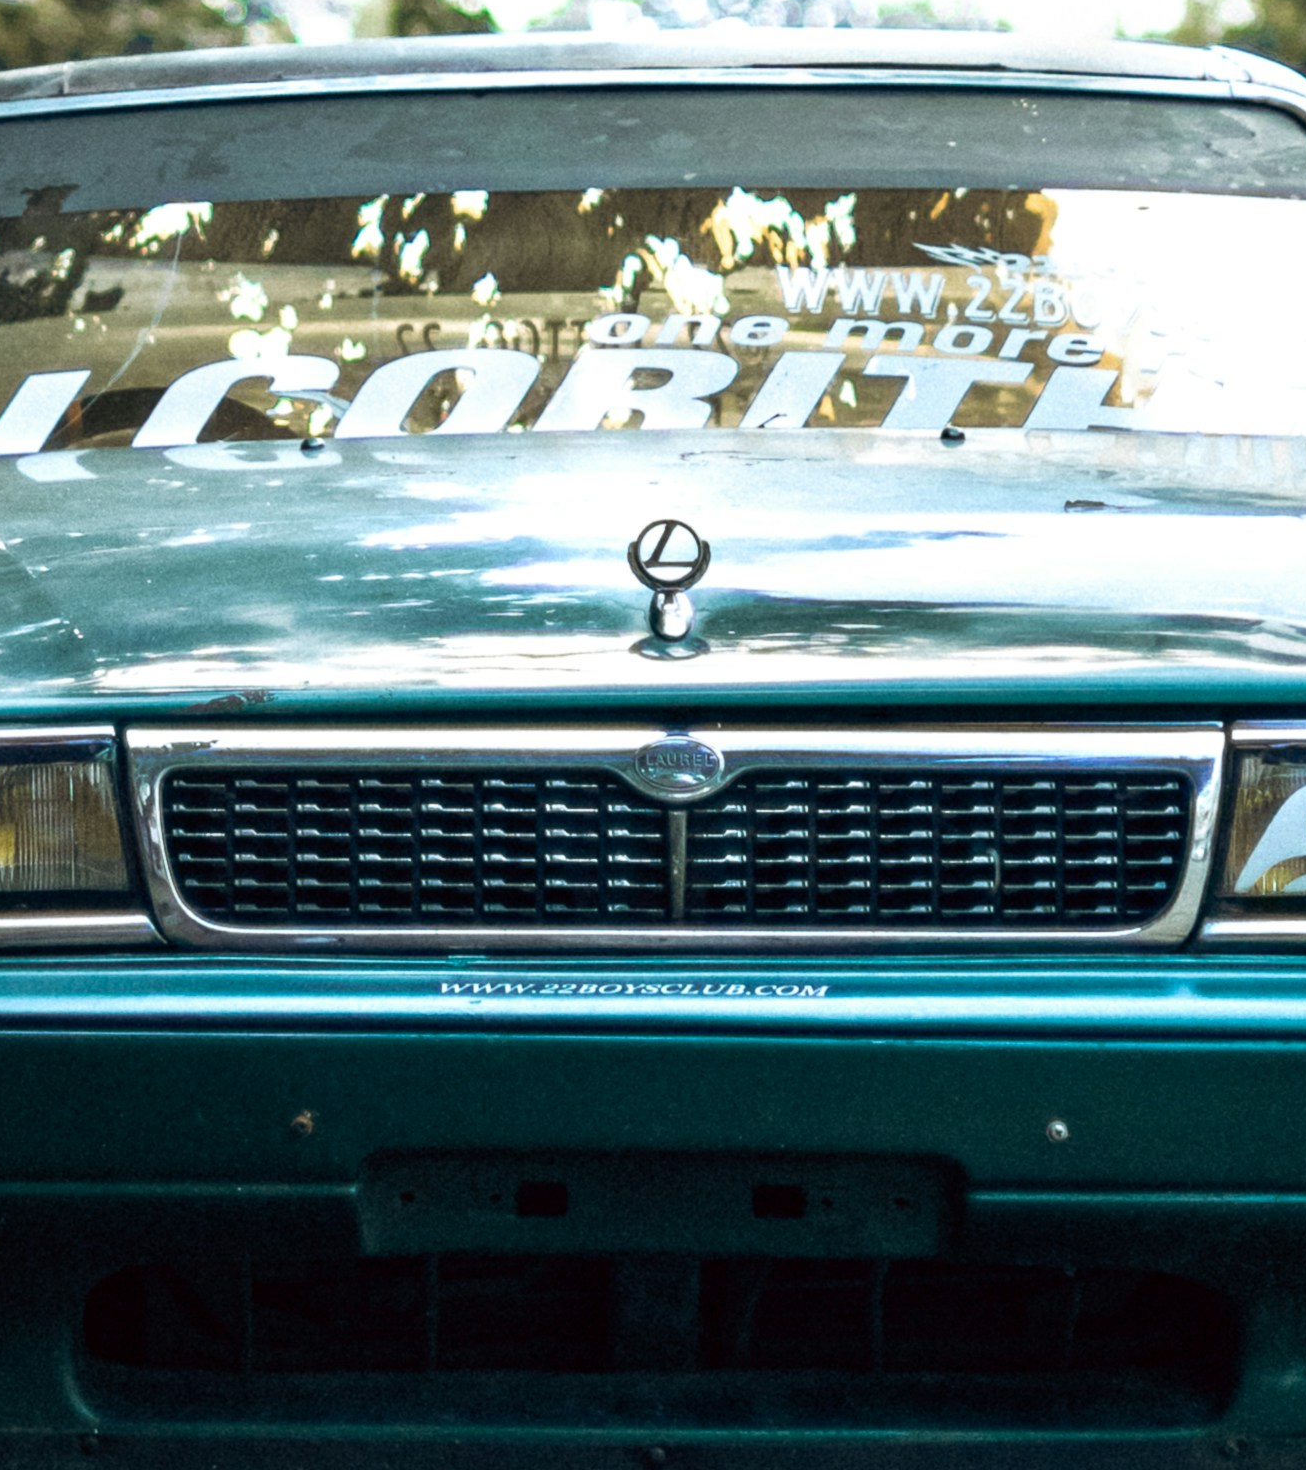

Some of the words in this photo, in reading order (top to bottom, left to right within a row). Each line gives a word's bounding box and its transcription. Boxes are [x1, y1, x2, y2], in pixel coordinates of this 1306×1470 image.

[590, 312, 790, 347] one
[823, 318, 1105, 366] more
[644, 751, 714, 768] LAUREL
[441, 982, 830, 997] WWW.22BOYSCLUB.COM
